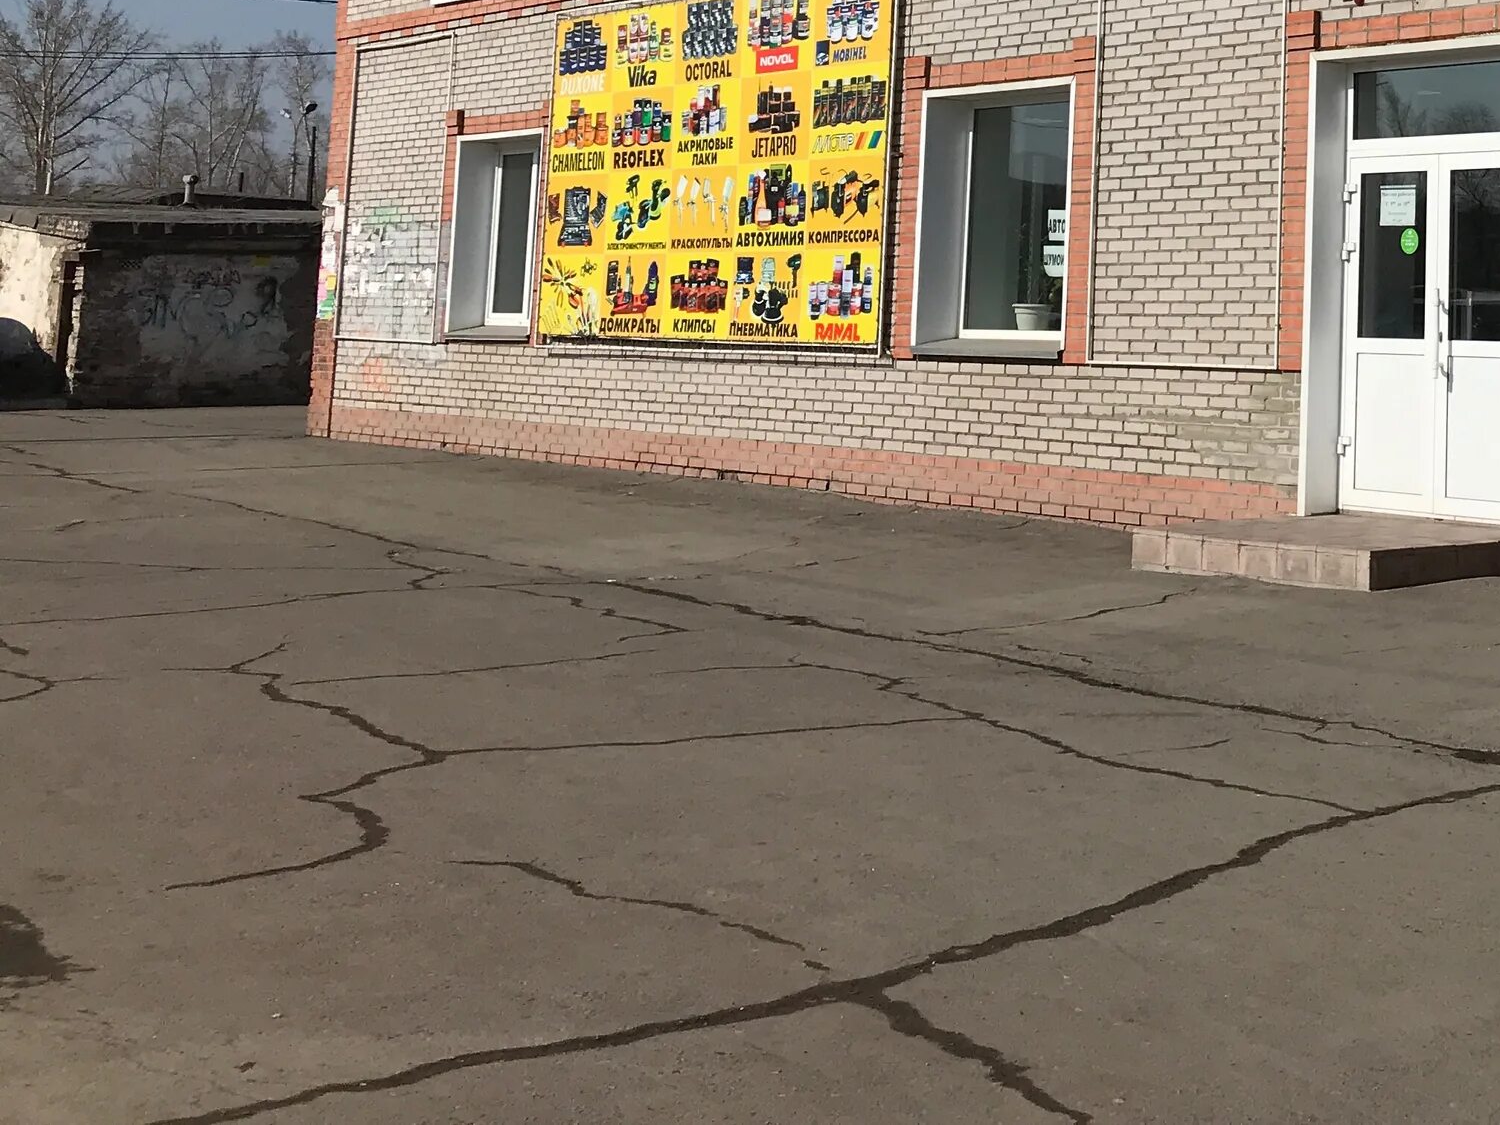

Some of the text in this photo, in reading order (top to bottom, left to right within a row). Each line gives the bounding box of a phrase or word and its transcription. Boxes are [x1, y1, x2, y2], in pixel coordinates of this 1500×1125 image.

[759, 53, 795, 67] NOVOL
[832, 46, 867, 62] MOBIHEL
[628, 65, 657, 88] Vika
[685, 59, 732, 82] OCTORAL
[560, 74, 605, 97] DUXONE
[677, 136, 734, 153] АКРИЛОВЫЕ
[751, 135, 797, 159] JETAPRO
[552, 151, 605, 173] CHAMELEON
[613, 149, 665, 169] REOFLEX
[691, 152, 718, 166] ЛАКИ
[671, 238, 733, 249] КРАСКОПУЛЬТЫ
[735, 230, 804, 248] АВТОХИМИЯ
[808, 229, 879, 244] КОМПРЕССОРА
[598, 317, 660, 334] ДОМКРАТЫ
[672, 319, 715, 333] КЛИПСЫ
[729, 321, 798, 338] ПНЕВМАТИКА
[815, 323, 860, 342] RANAL
